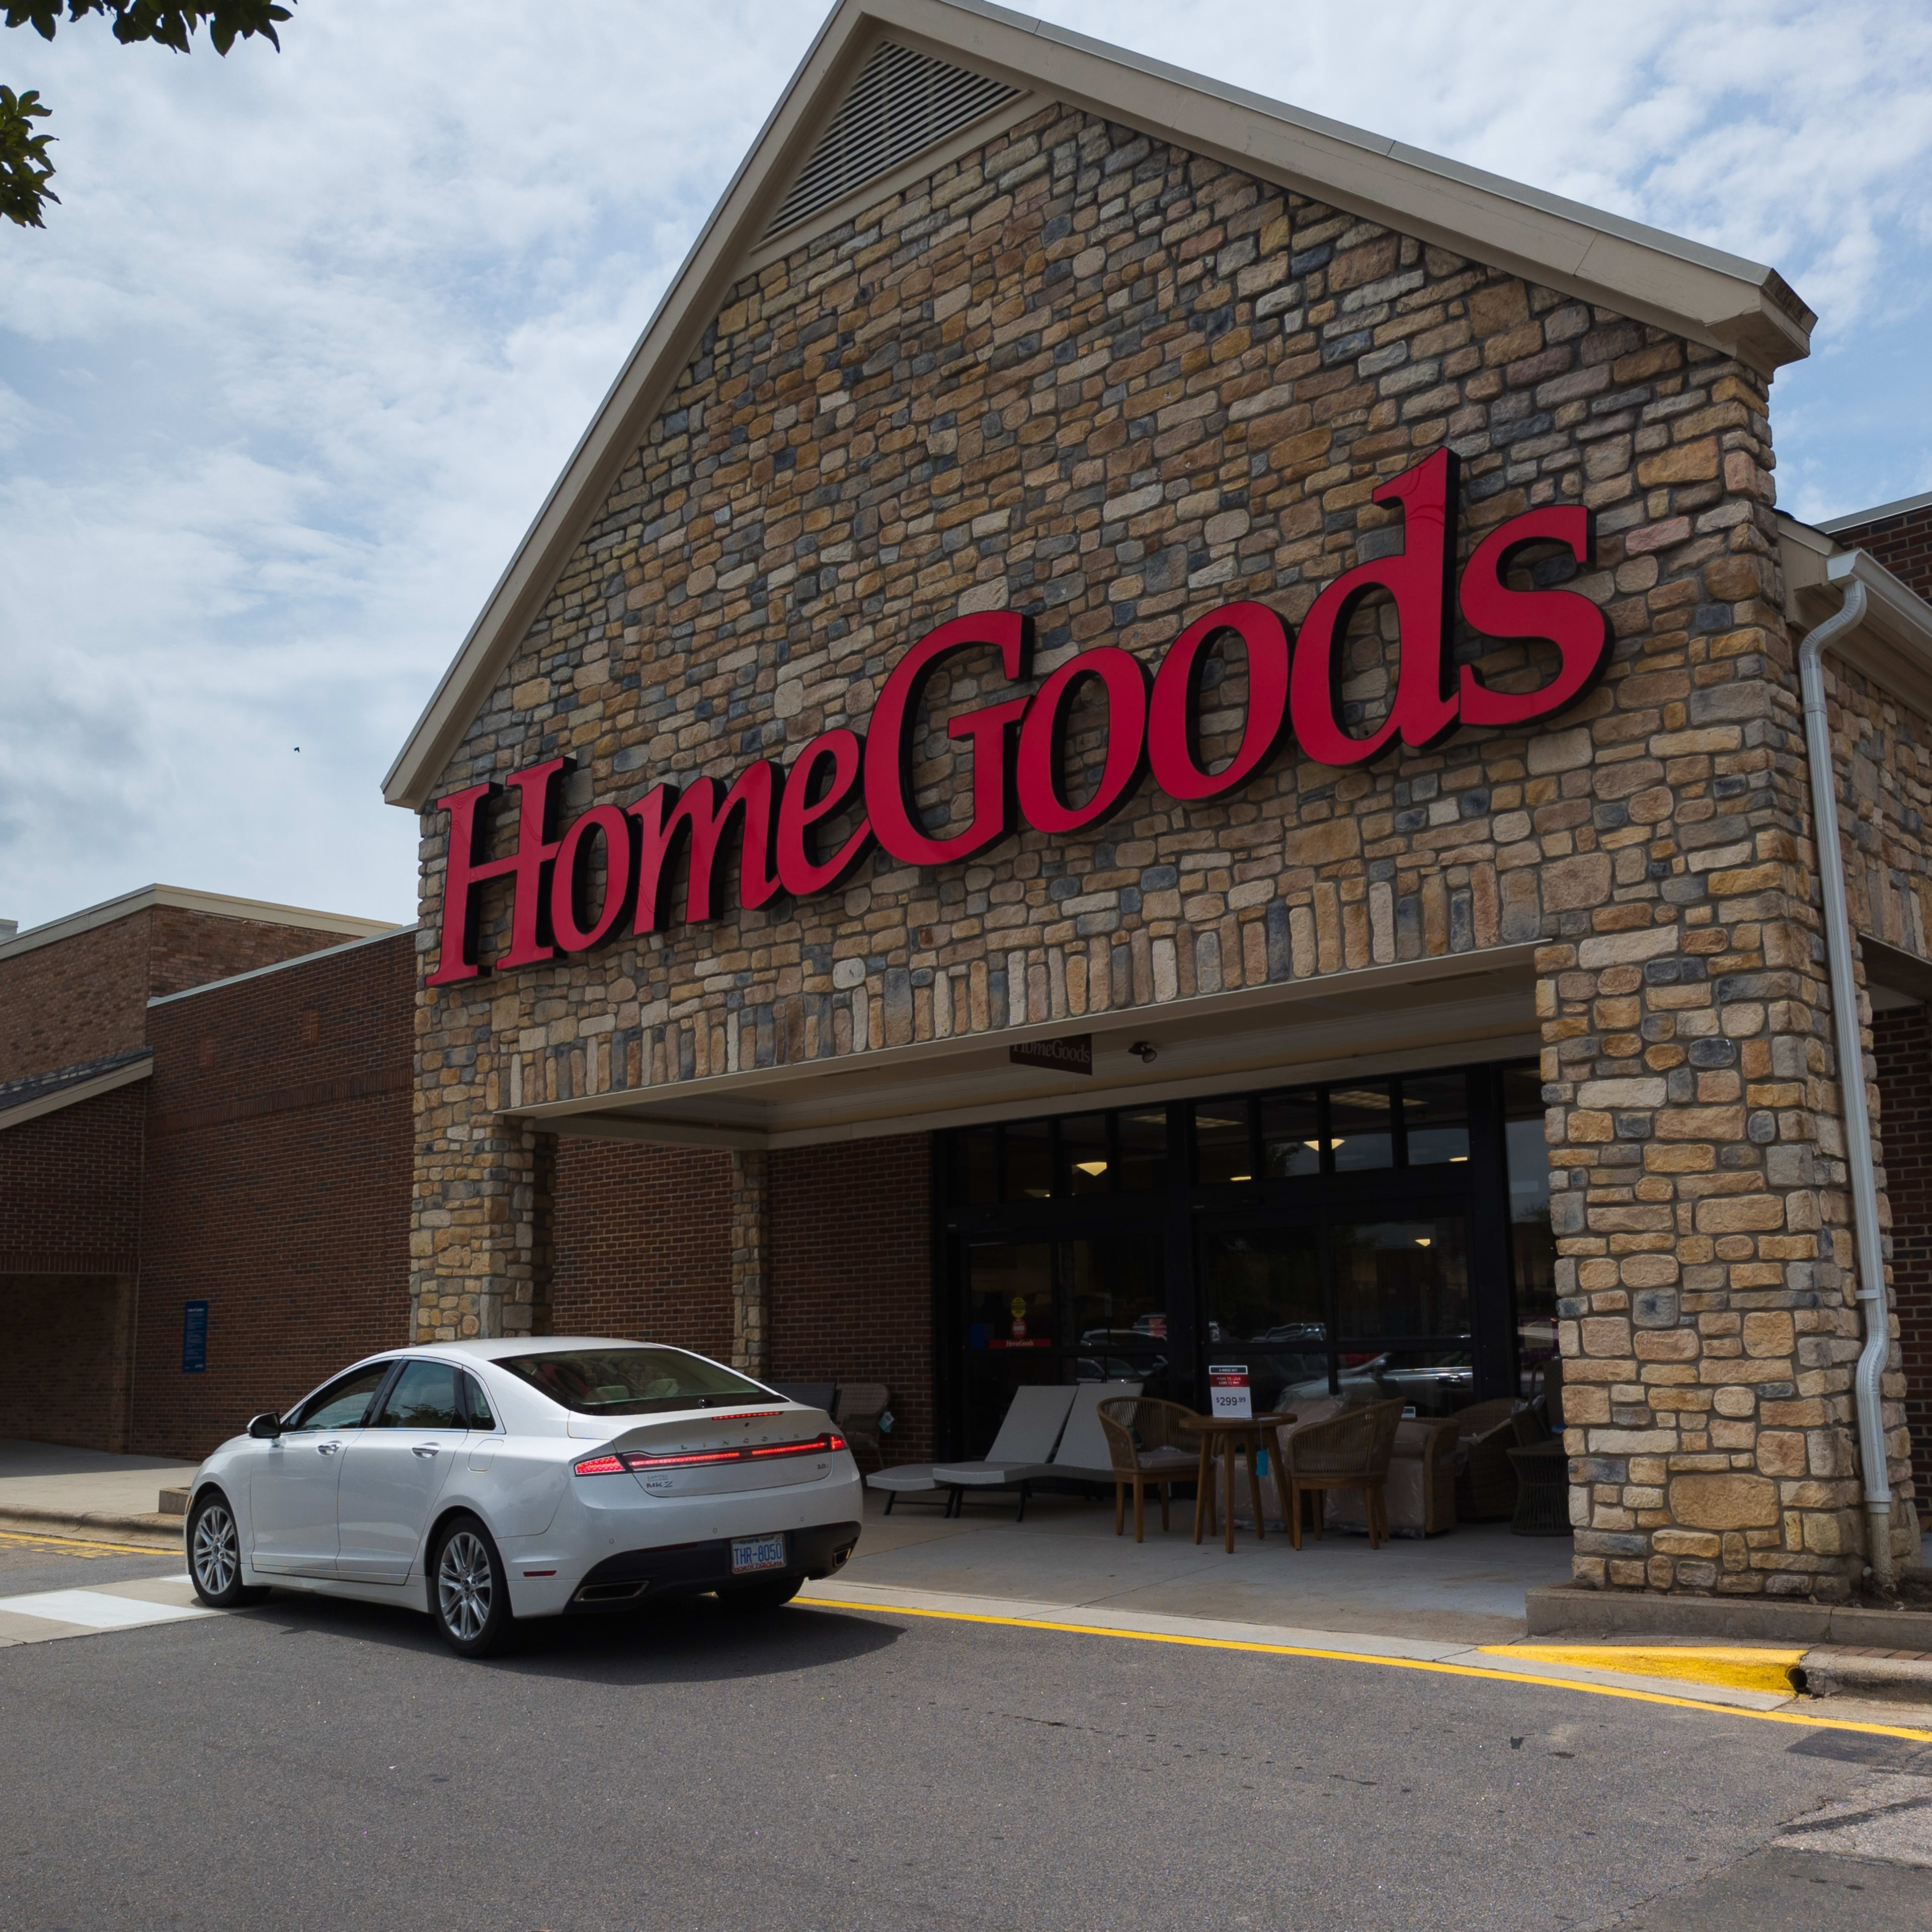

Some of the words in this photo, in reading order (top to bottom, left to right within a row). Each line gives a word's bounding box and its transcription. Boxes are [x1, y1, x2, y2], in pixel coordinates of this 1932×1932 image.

[425, 445, 1606, 987] HomeGoods
[681, 1433, 799, 1450] LINCOLN
[734, 1543, 782, 1566] THR-8050
